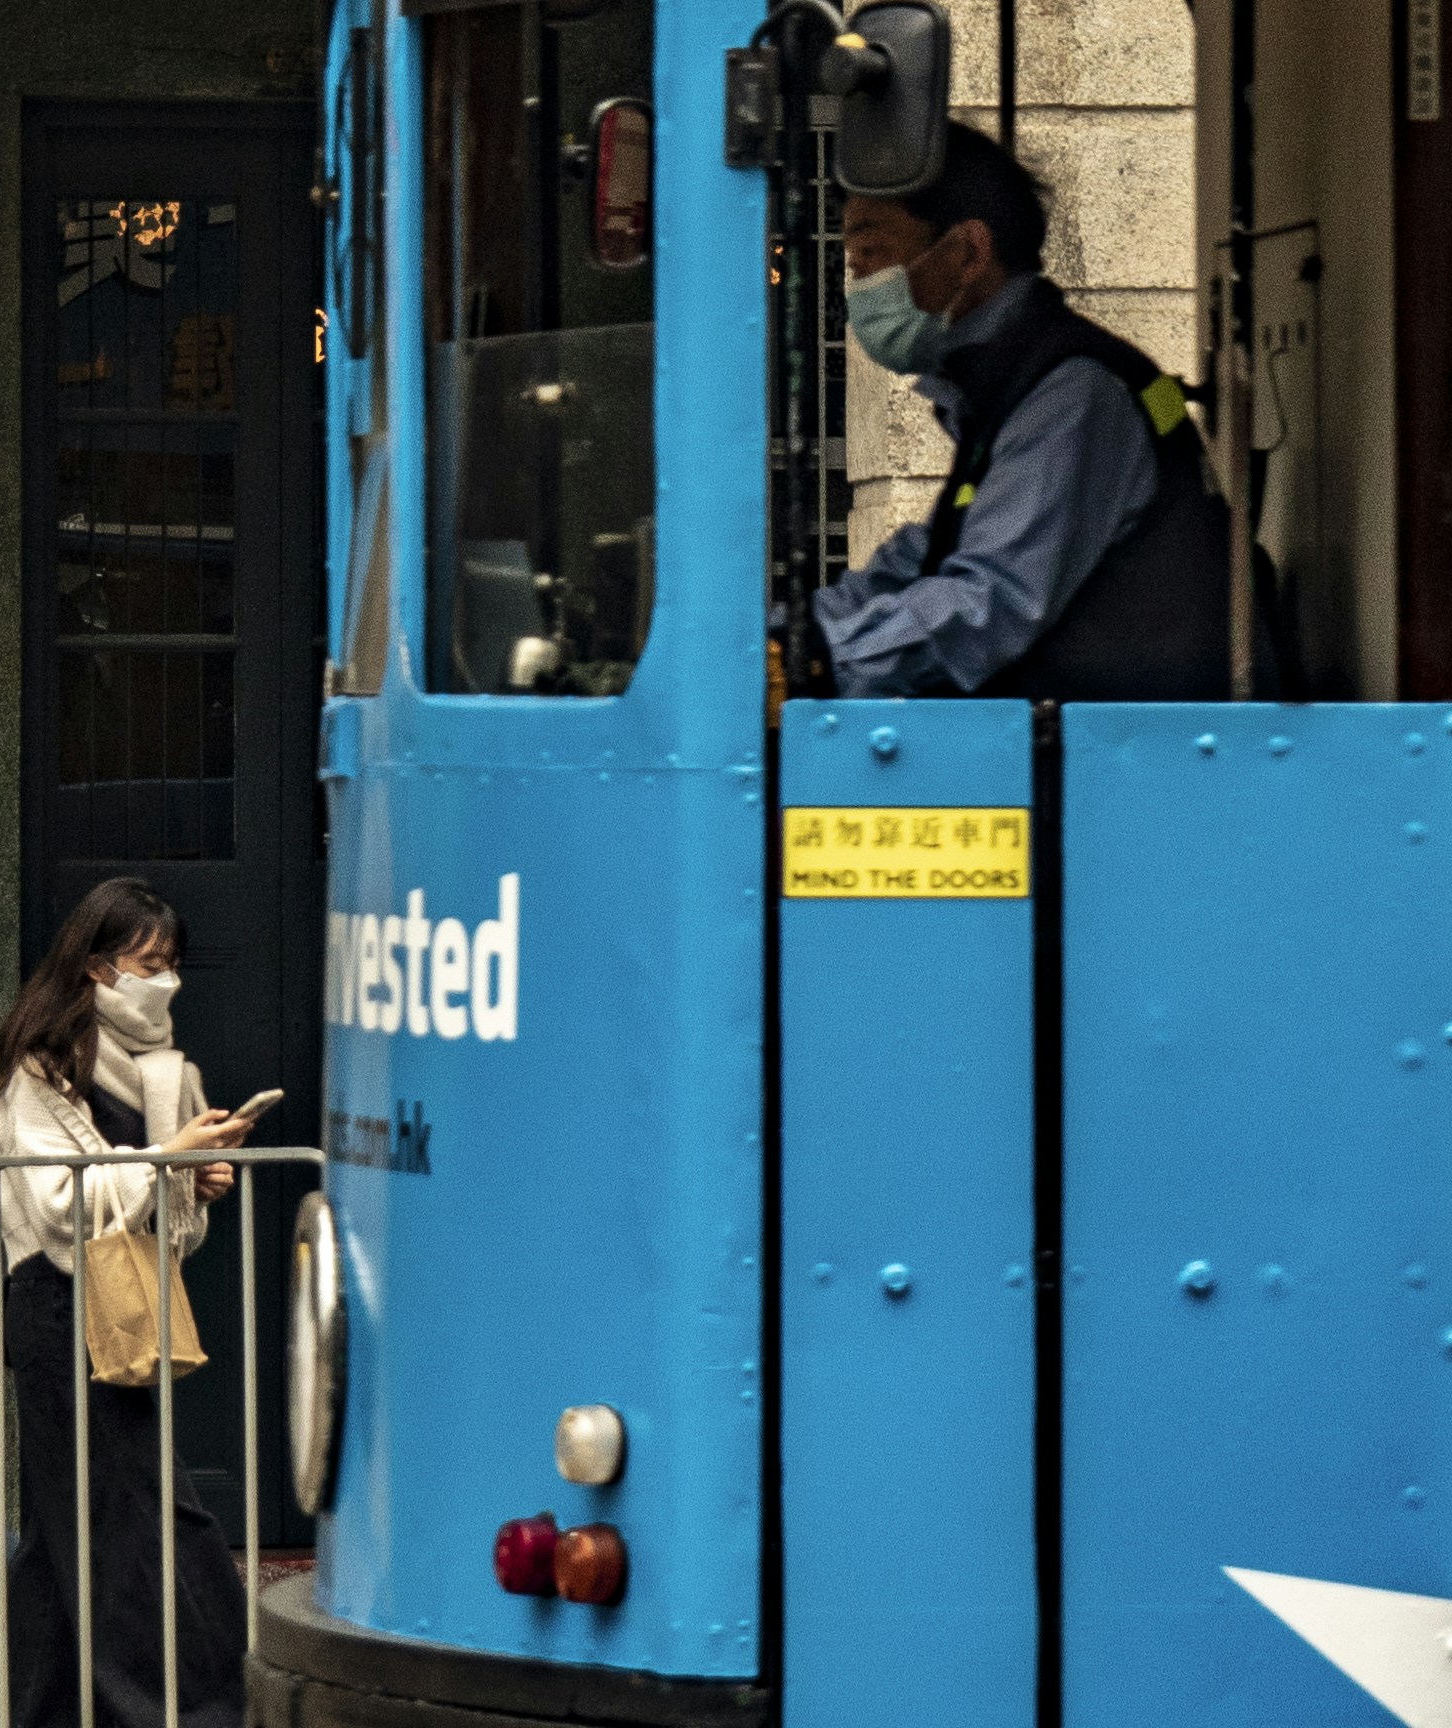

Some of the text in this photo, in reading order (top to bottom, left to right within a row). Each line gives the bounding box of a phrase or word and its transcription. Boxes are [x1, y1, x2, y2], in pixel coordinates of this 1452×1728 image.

[791, 869, 1021, 889] MIND THE DOORS
